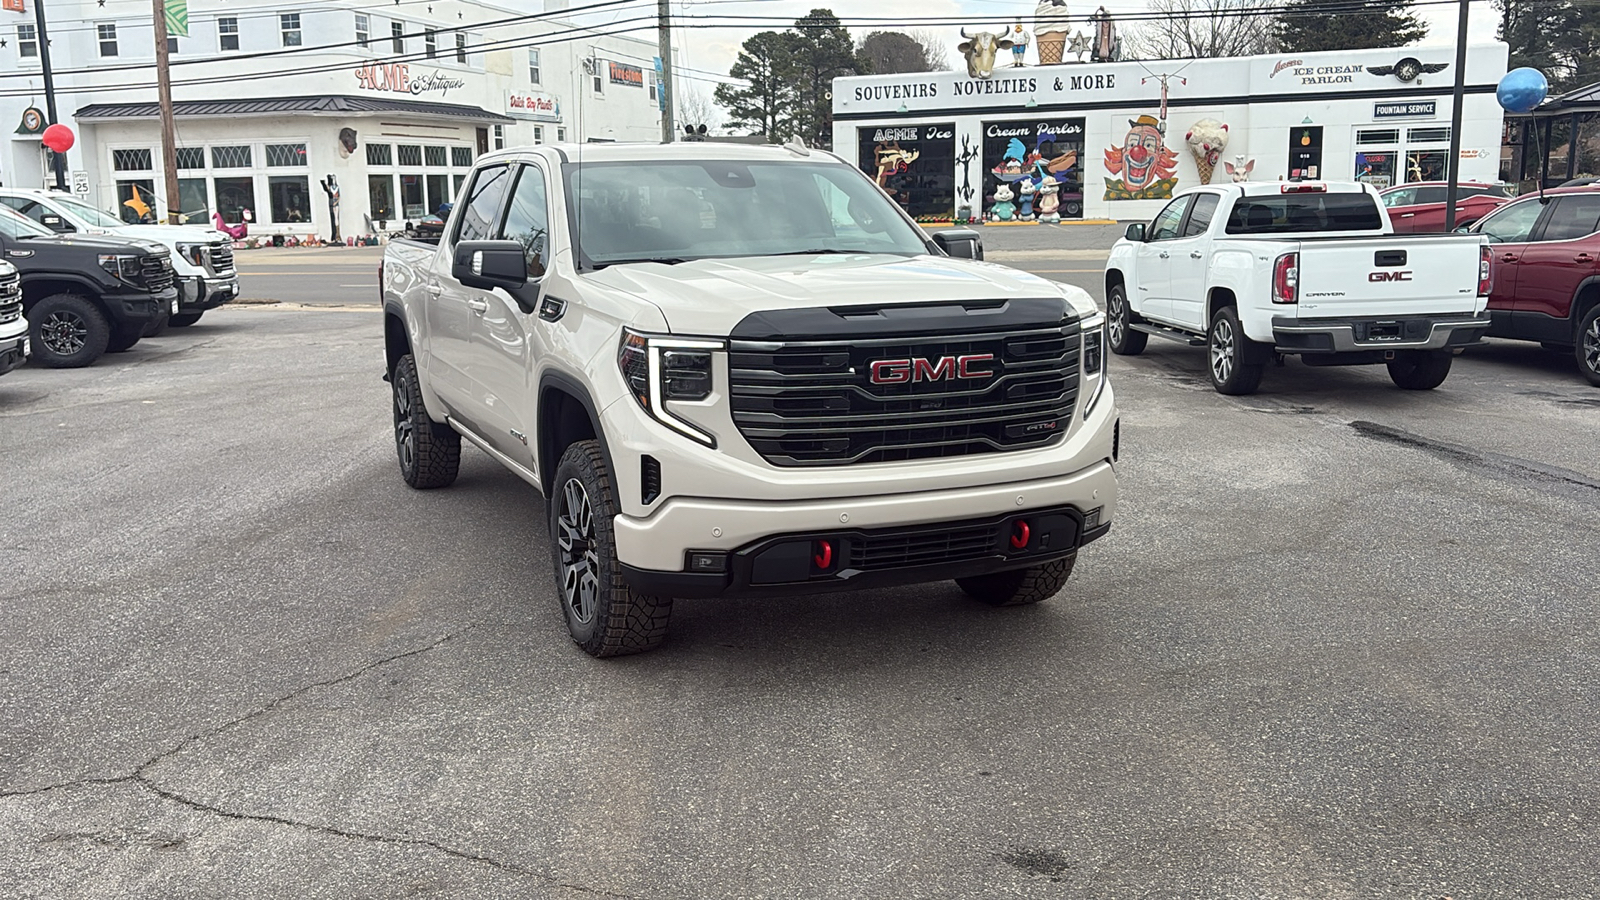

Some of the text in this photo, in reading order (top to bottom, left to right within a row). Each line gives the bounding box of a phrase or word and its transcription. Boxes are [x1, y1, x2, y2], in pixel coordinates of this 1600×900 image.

[609, 61, 642, 84] Firestone
[1293, 64, 1363, 76] ICE CREAM
[355, 60, 465, 97] ACME Antiques
[1301, 75, 1352, 85] PARLOR
[855, 74, 1116, 101] SOUVENIRS NOVELTIES & MORE
[510, 95, 553, 112] Dutch Boy Paints
[1376, 104, 1434, 115] FOUNTAIN SERVICE
[873, 126, 953, 141] ACME Ice
[986, 122, 1082, 138] Cream Parlor
[75, 182, 89, 192] 25
[1368, 271, 1413, 283] GMC
[869, 353, 994, 385] GMC
